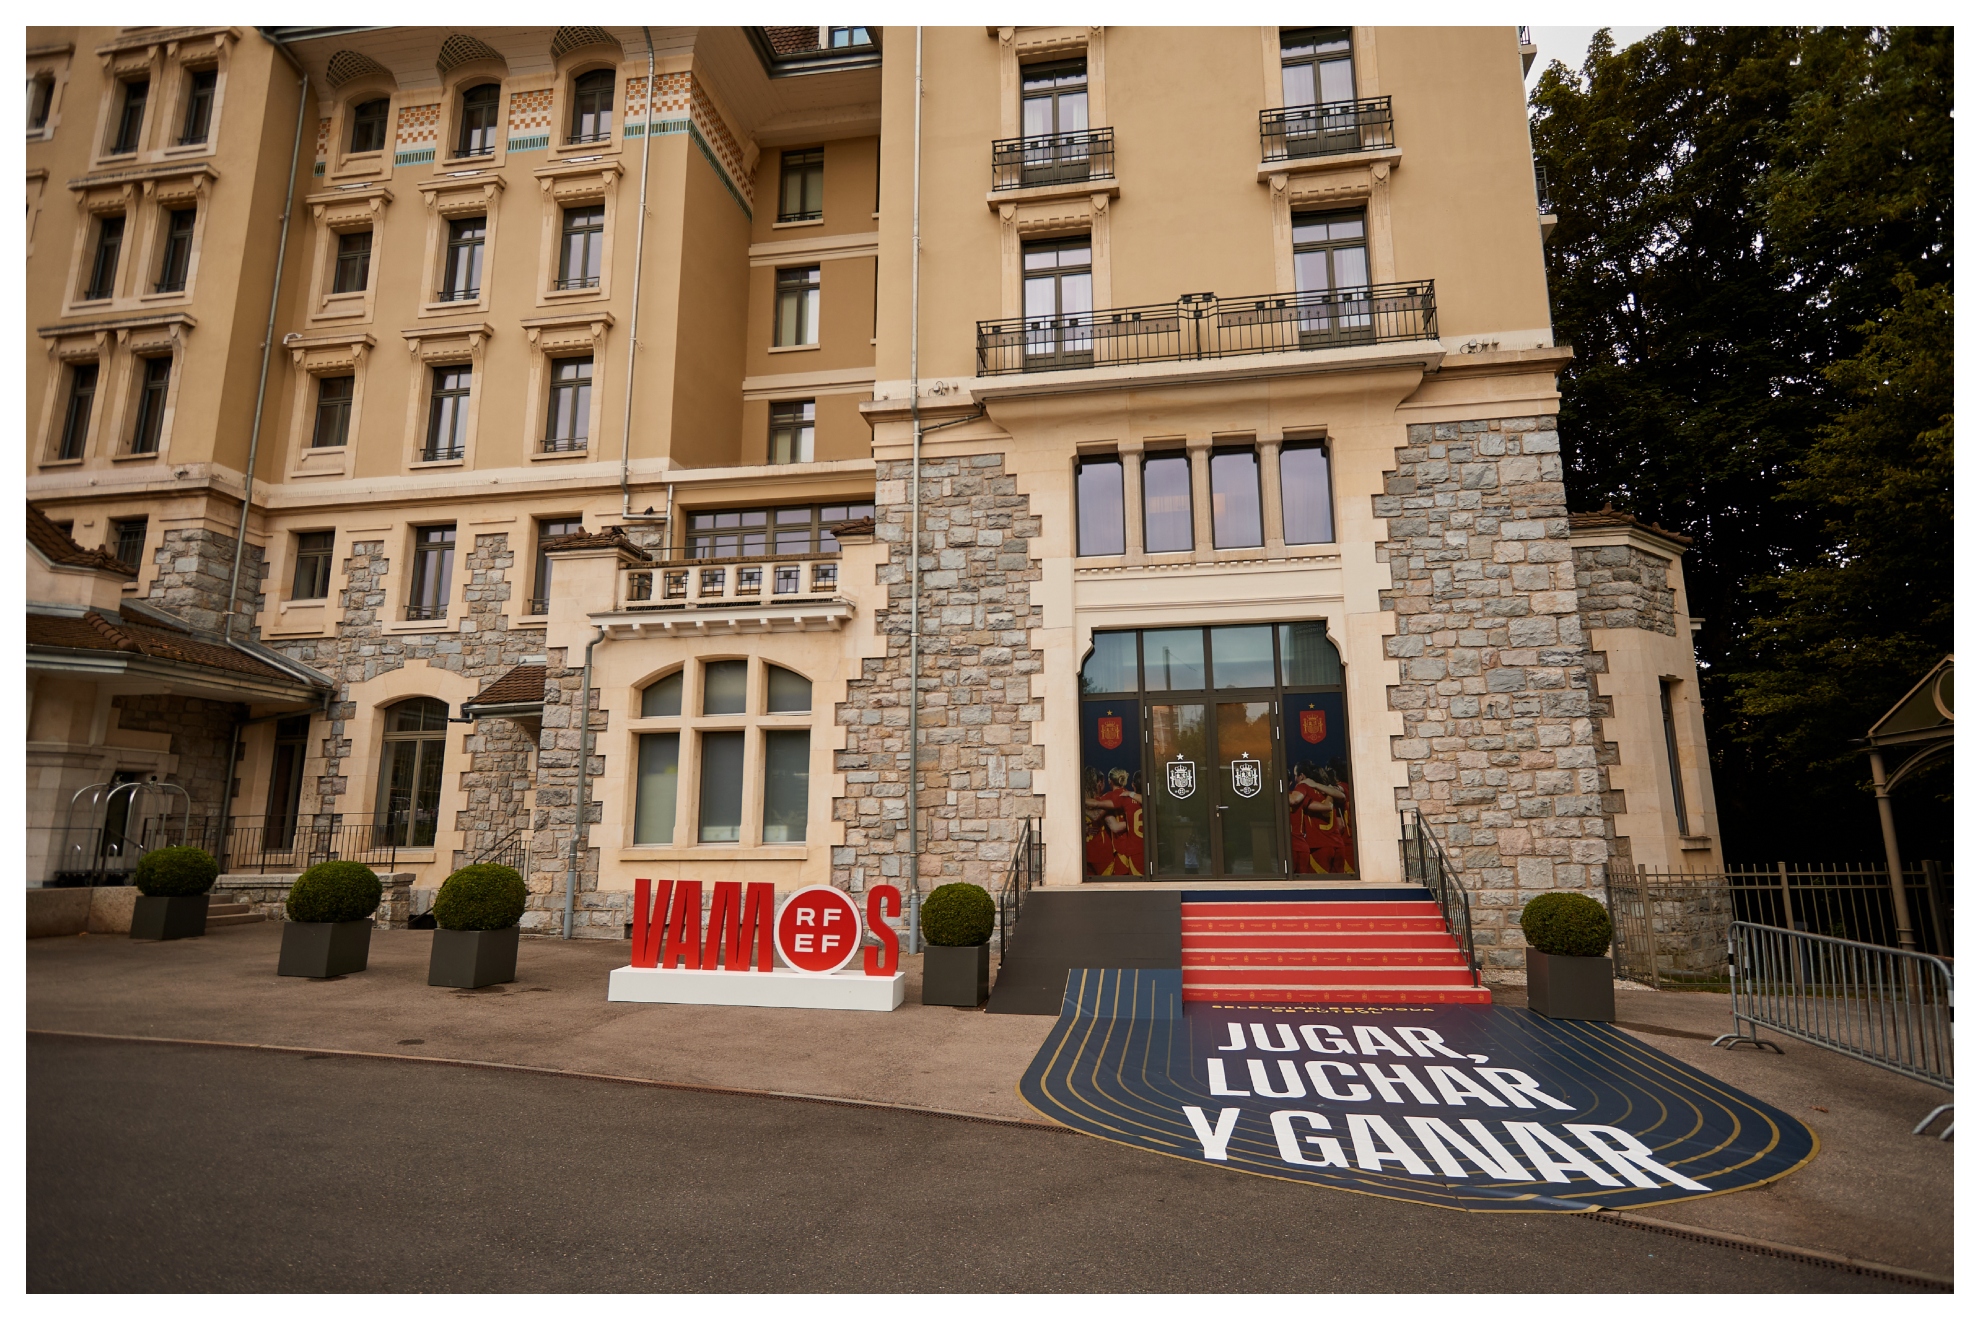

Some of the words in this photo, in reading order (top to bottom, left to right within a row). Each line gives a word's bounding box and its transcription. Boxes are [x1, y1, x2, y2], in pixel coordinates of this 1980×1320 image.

[1218, 1022, 1489, 1064] JUGAR,
[1207, 1058, 1577, 1111] LUCHAR
[1182, 1105, 1241, 1161] Y
[1269, 1111, 1713, 1191] GANAR
